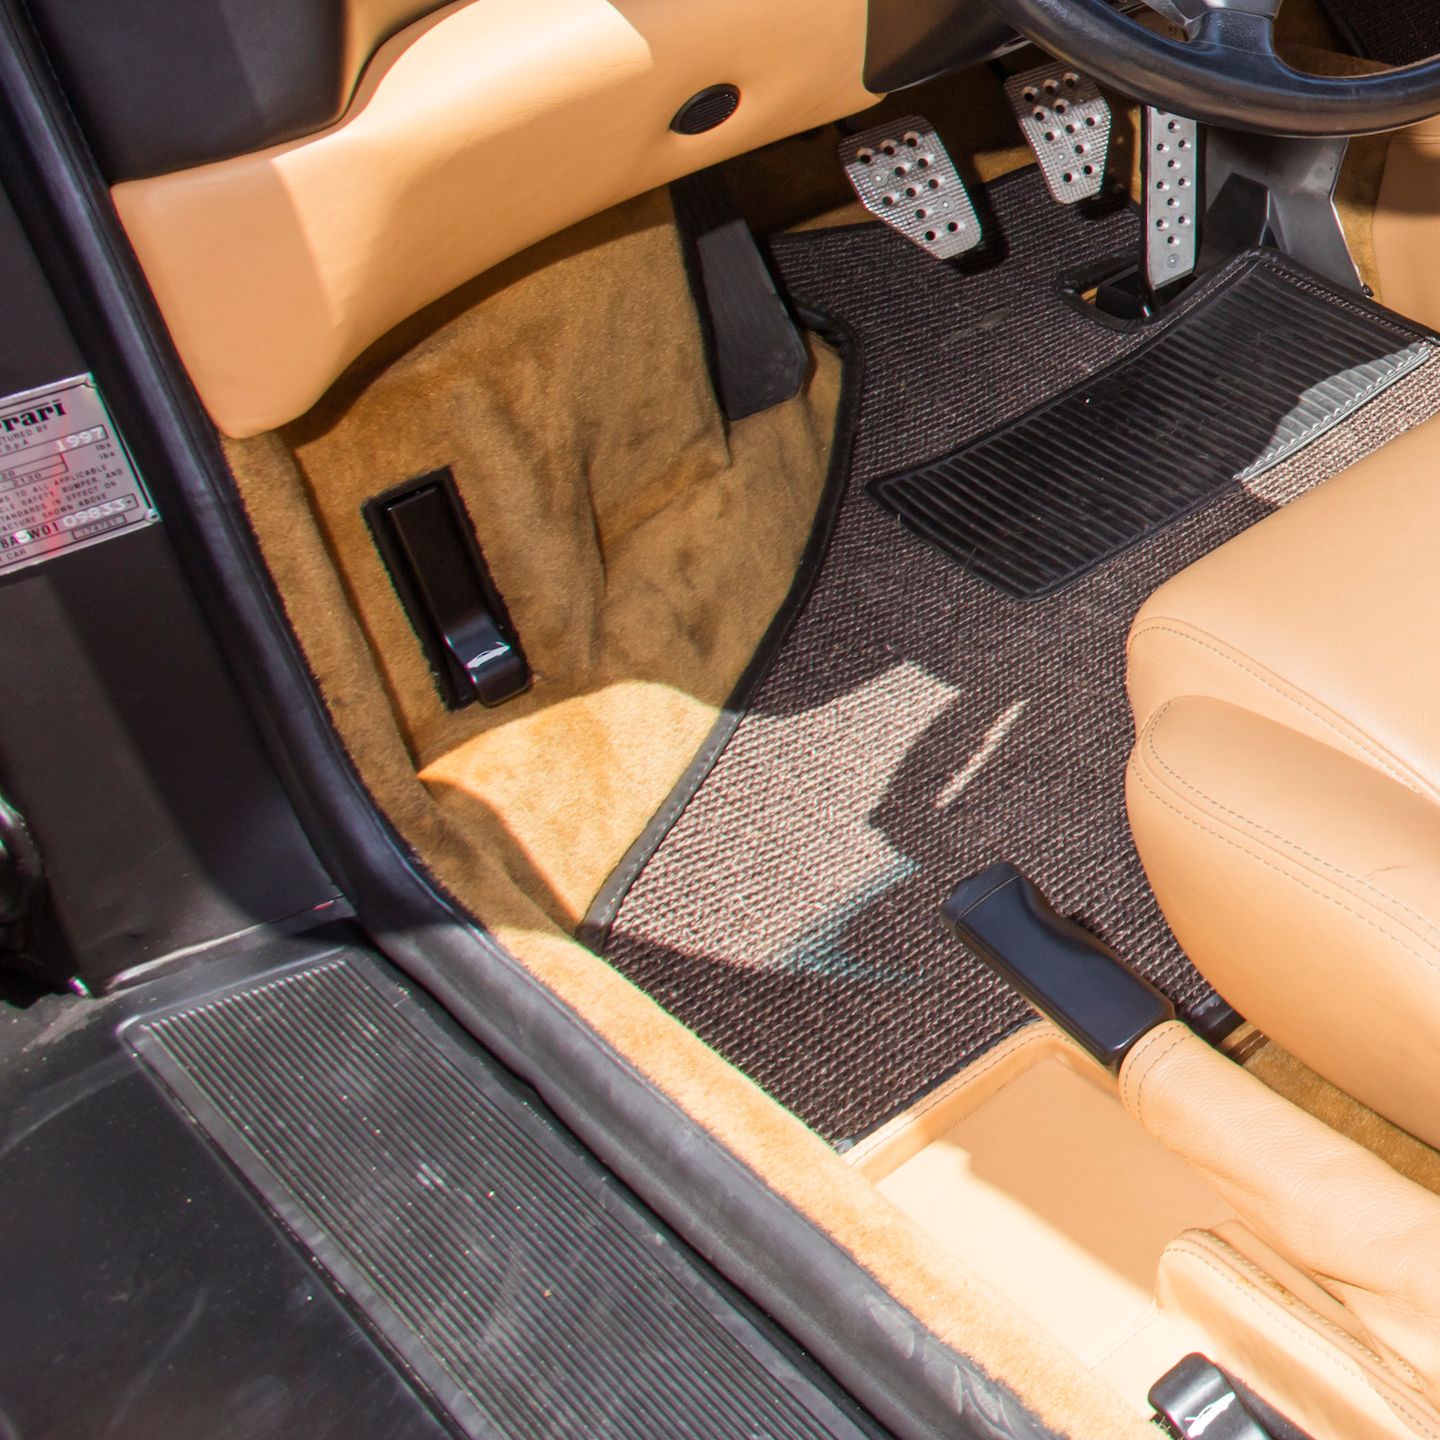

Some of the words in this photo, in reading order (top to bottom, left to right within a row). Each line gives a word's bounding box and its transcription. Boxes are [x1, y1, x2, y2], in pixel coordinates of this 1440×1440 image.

[57, 426, 104, 451] 1997
[106, 468, 123, 479] AND
[104, 481, 116, 489] ON
[79, 492, 107, 506] ABOVE
